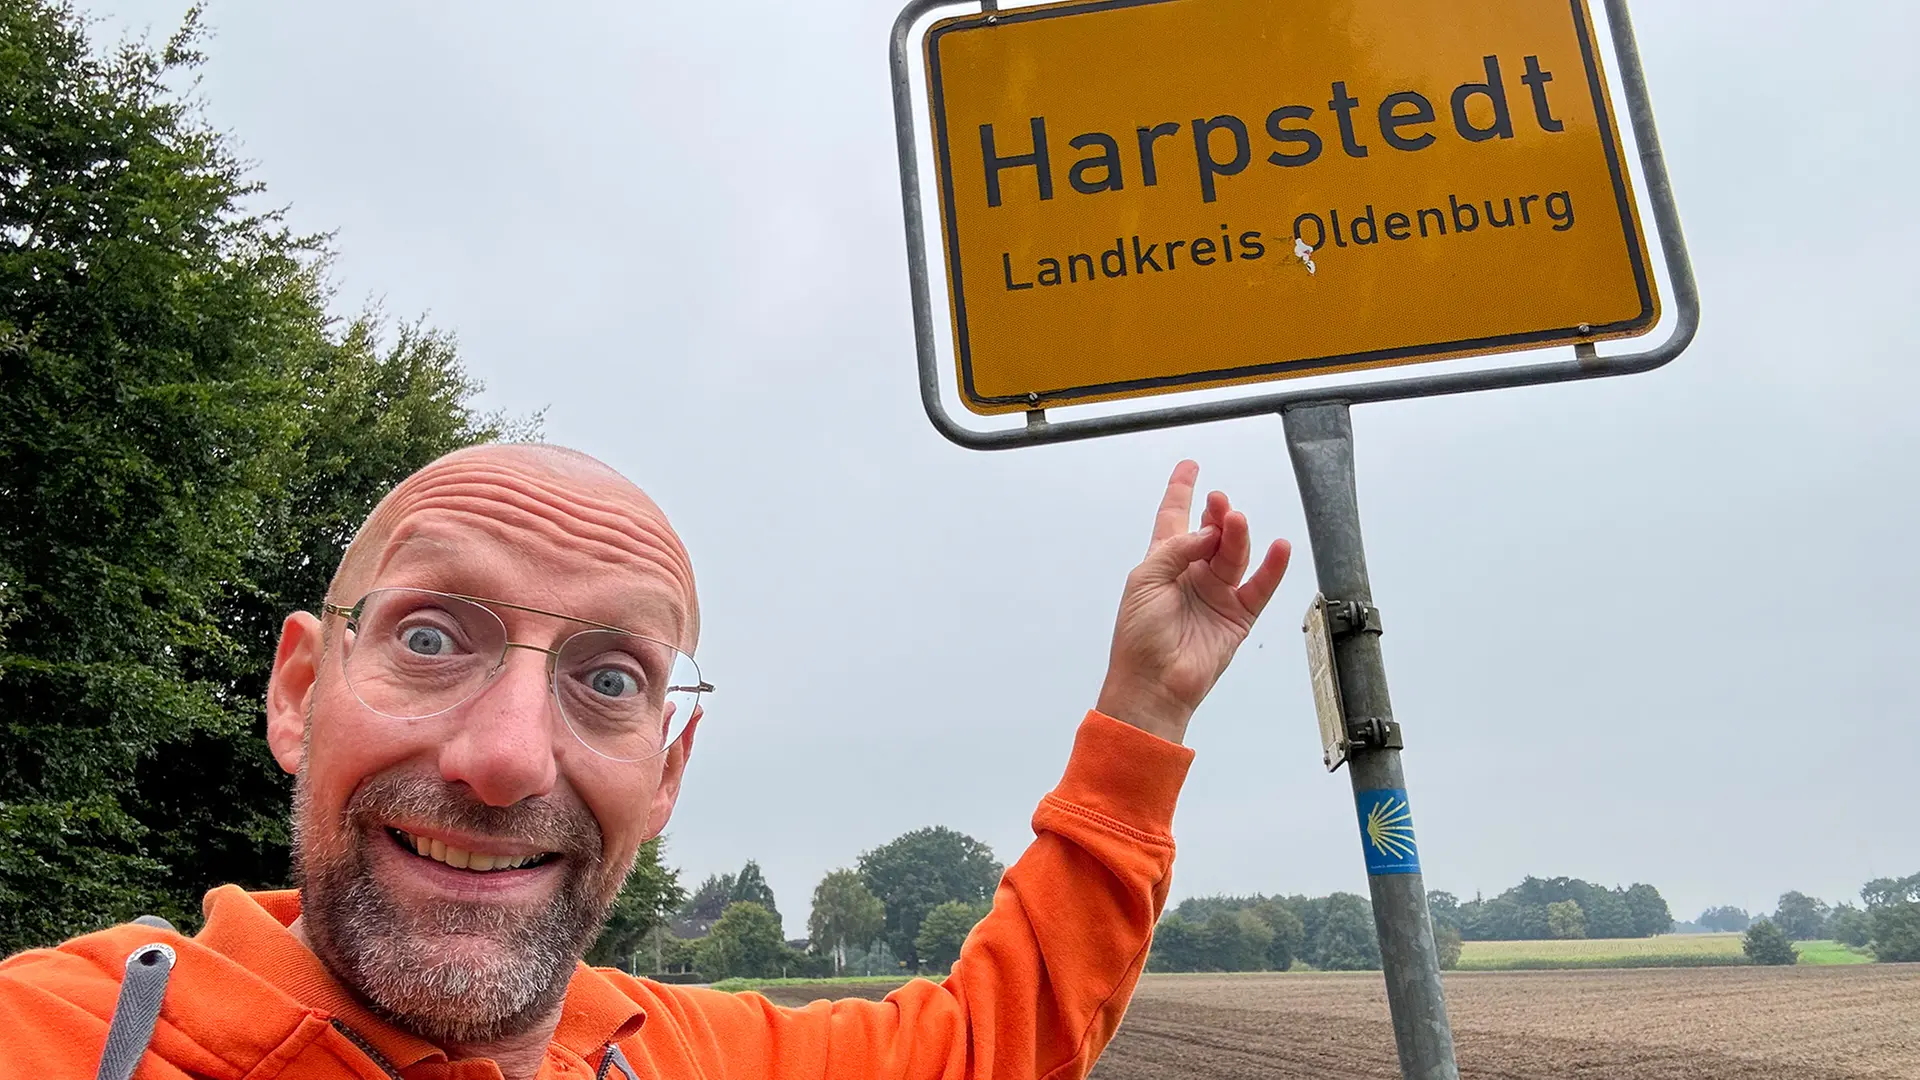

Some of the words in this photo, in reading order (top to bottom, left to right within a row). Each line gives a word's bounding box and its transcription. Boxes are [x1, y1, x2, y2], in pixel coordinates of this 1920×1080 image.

[979, 54, 1565, 209] Harpstedt
[1003, 224, 1266, 291] Landkreis
[1293, 190, 1576, 254] Oldenburg
